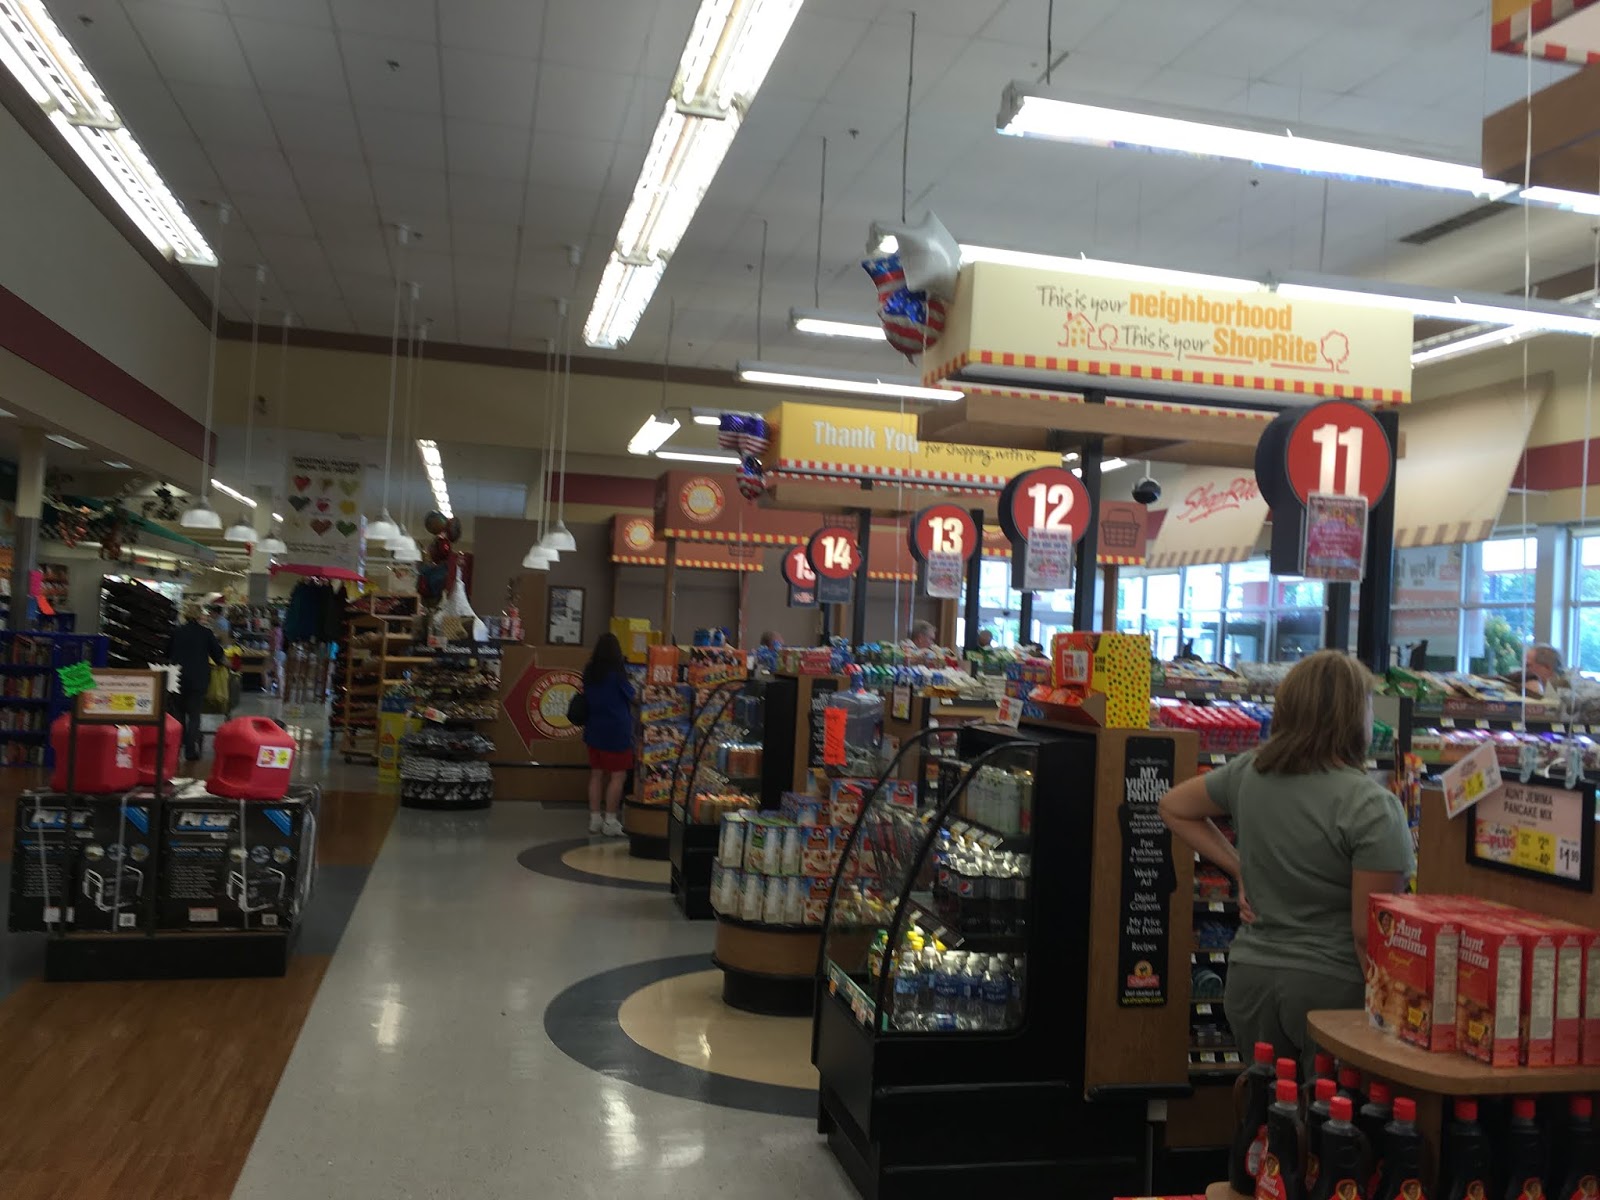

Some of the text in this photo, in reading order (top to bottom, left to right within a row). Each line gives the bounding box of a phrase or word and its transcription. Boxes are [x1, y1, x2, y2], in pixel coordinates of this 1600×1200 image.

[1036, 285, 1293, 331] This is your neighborhood
[1121, 325, 1318, 363] This is your ShopRite
[813, 420, 921, 454] Thank You
[1312, 423, 1364, 496] 11
[1027, 482, 1075, 531] 12
[928, 516, 964, 555] 13
[821, 536, 852, 570] 14
[1139, 766, 1159, 779] MY
[1125, 777, 1169, 791] VIRTUAL
[1504, 787, 1553, 806] AUNT JEMIMA
[1503, 801, 1553, 821] PANCAKE MIX
[1489, 835, 1516, 849] PLUS
[1133, 868, 1159, 880] Weekly
[1140, 879, 1152, 887] Ad
[1129, 901, 1161, 912] Coupons
[1134, 892, 1157, 904] Digital
[1128, 916, 1161, 927] My Price
[1396, 917, 1423, 940] Aunt
[1131, 941, 1157, 952] Recipes
[1383, 934, 1428, 958] Jemima
